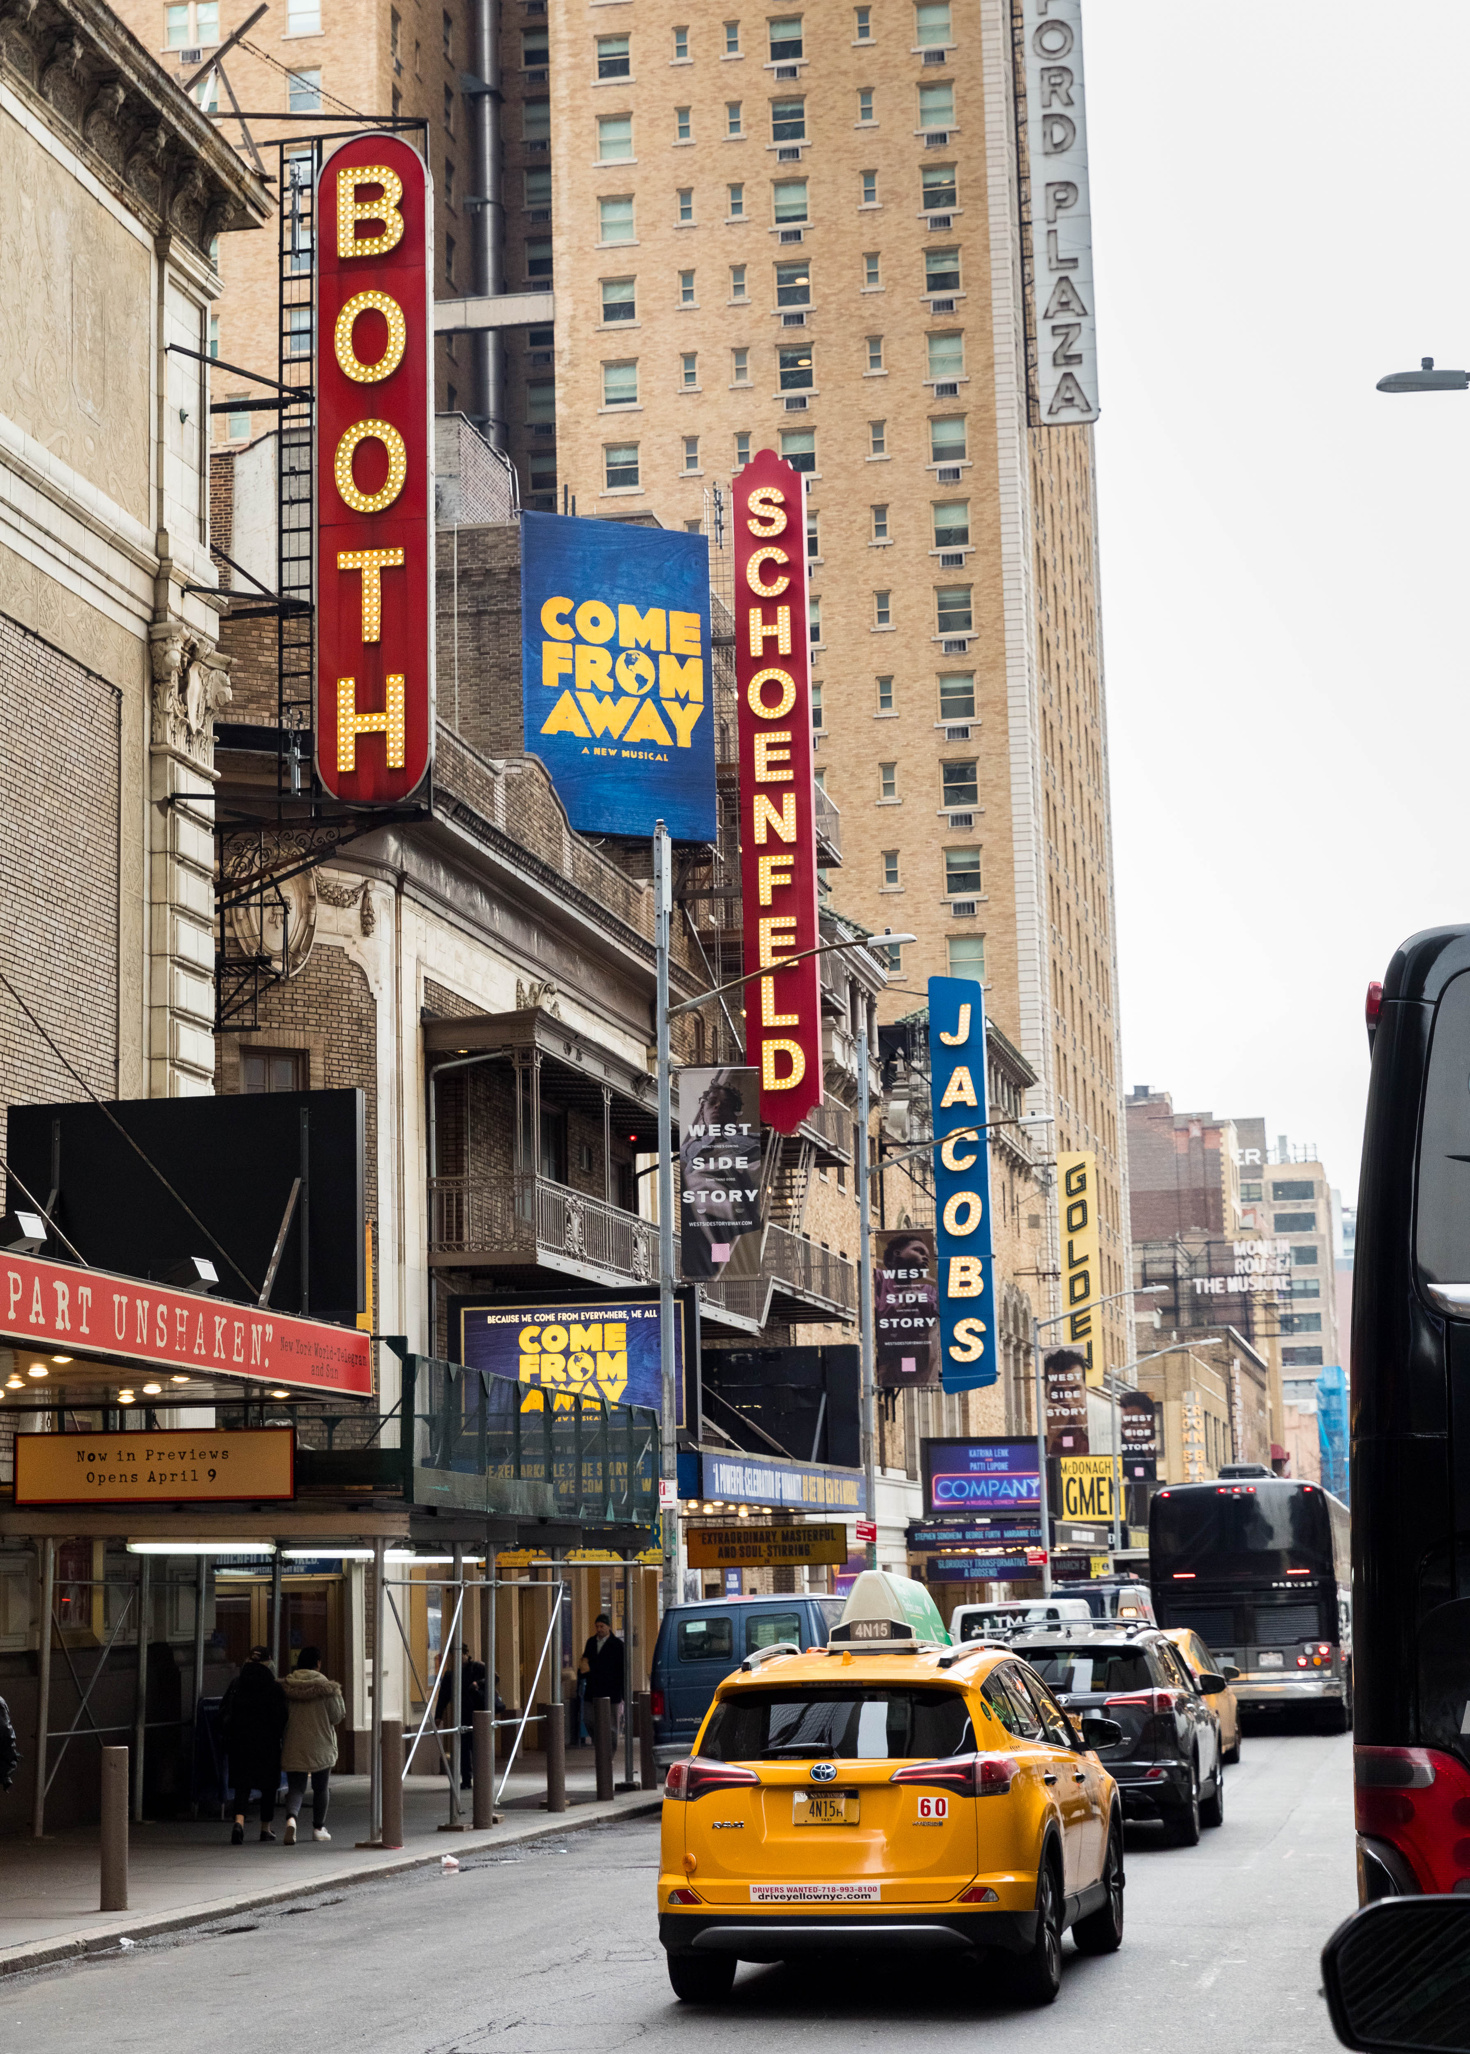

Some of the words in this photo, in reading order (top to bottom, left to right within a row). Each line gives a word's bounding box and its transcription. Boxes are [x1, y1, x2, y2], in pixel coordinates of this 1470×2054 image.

[1043, 181, 1092, 415] PLAZA
[334, 166, 407, 772] BOOTH
[541, 596, 702, 656] COME
[542, 640, 704, 702] FROM
[540, 689, 704, 748] AWAY
[581, 746, 590, 755] A
[593, 747, 617, 757] NEW
[622, 749, 669, 762] MUSICAL
[746, 487, 806, 1091] SCHOENFELD
[688, 1123, 751, 1137] WEST
[692, 1157, 748, 1170] SIDE
[938, 1003, 987, 1362] JACOBS
[682, 1189, 758, 1204] STORY
[882, 1268, 929, 1279] WEST
[1192, 1278, 1226, 1294] THE
[1227, 1275, 1292, 1293] MUSICAL
[7, 1270, 92, 1334] PART
[886, 1293, 928, 1304] SIDE
[487, 1315, 519, 1324] BECAUSE
[521, 1314, 532, 1323] WE
[534, 1313, 555, 1322] COME
[558, 1312, 579, 1321] FROM
[581, 1310, 629, 1320] EVERYWHERE,
[631, 1310, 642, 1318] WE
[644, 1309, 657, 1318] ALL
[879, 1317, 936, 1329] STORY
[518, 1323, 627, 1354] COME
[280, 1336, 293, 1351] New
[296, 1339, 312, 1356] York
[314, 1342, 367, 1367] World-Telegram
[311, 1363, 324, 1377] and
[326, 1364, 339, 1379] Sun
[519, 1352, 628, 1383] FROM
[1048, 1373, 1082, 1382] WEST
[1051, 1390, 1081, 1399] SIDE
[1046, 1408, 1087, 1417] STORY
[1123, 1414, 1152, 1422] WEST
[1124, 1429, 1151, 1437] SIDE
[969, 1449, 993, 1457] KATRINA
[994, 1449, 1009, 1457] LENK
[1120, 1443, 1156, 1451] STORY
[77, 1450, 107, 1462] Now
[117, 1450, 136, 1461] in
[145, 1449, 229, 1461] Previews
[969, 1462, 986, 1471] PATTI
[1061, 1461, 1120, 1475] McDONAGHS
[86, 1471, 138, 1485] Opens
[147, 1469, 199, 1485] April
[207, 1468, 217, 1482] 9
[937, 1476, 1040, 1498] COMPANY
[781, 1529, 836, 1542] MASTERFUL
[718, 1546, 736, 1559] AND
[855, 1622, 888, 1637] 4N15
[809, 1800, 843, 1817] 4N15H
[920, 1798, 946, 1817] 60
[752, 1886, 785, 1894] DRIVERS
[758, 1892, 871, 1901] driveyellownyc.com
